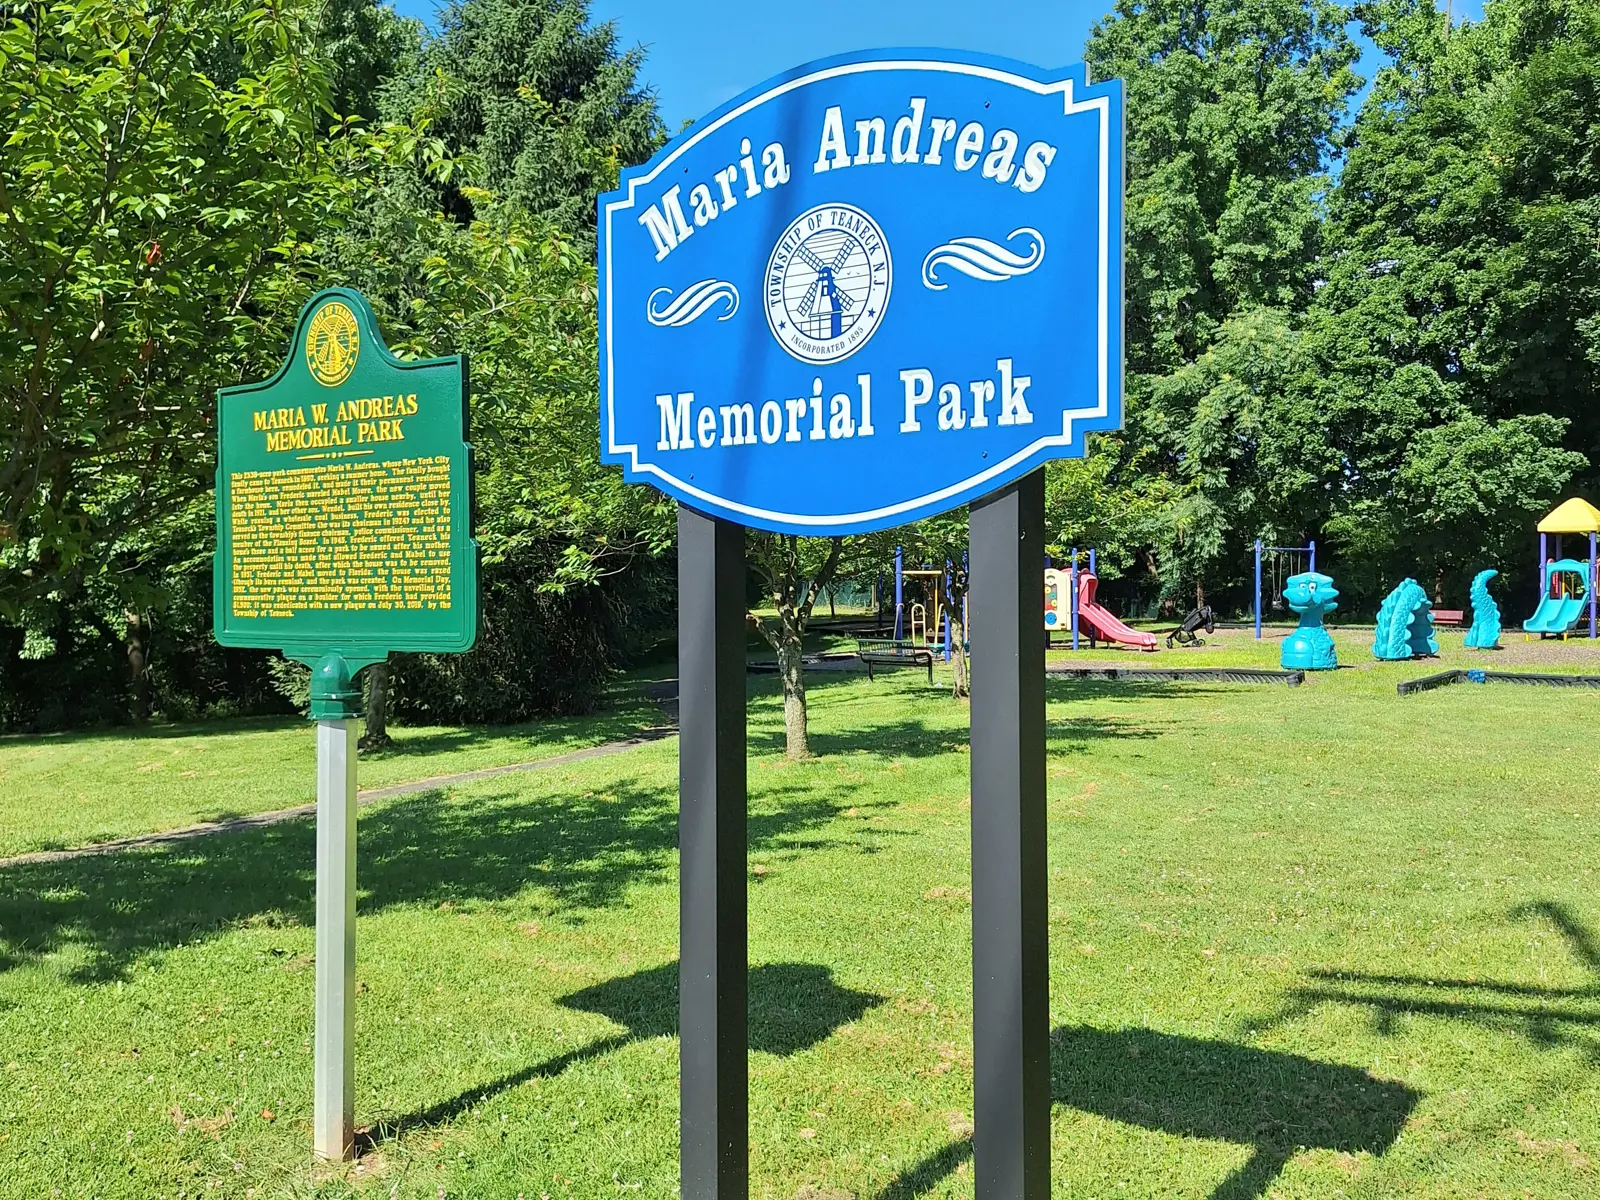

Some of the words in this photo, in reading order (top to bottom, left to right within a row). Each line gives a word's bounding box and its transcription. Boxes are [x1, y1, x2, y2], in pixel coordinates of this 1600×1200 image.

[637, 137, 790, 262] Maria
[813, 97, 1057, 194] Andreas
[770, 228, 801, 307] TOWNSHIP
[808, 214, 822, 230] OF
[831, 211, 880, 256] TEANECK
[872, 261, 885, 292] N.J.
[308, 311, 324, 356] TOWNSHIP
[334, 305, 357, 334] TEANECK
[790, 334, 846, 354] INCORPORATED
[848, 326, 864, 344] 1895
[254, 406, 306, 432] MARIA
[312, 403, 329, 424] W.
[336, 394, 418, 422] ANDREAS
[656, 374, 875, 451] Memorial
[898, 358, 1034, 433] Park
[266, 426, 352, 452] MEMORIAL
[358, 419, 405, 443] PARK
